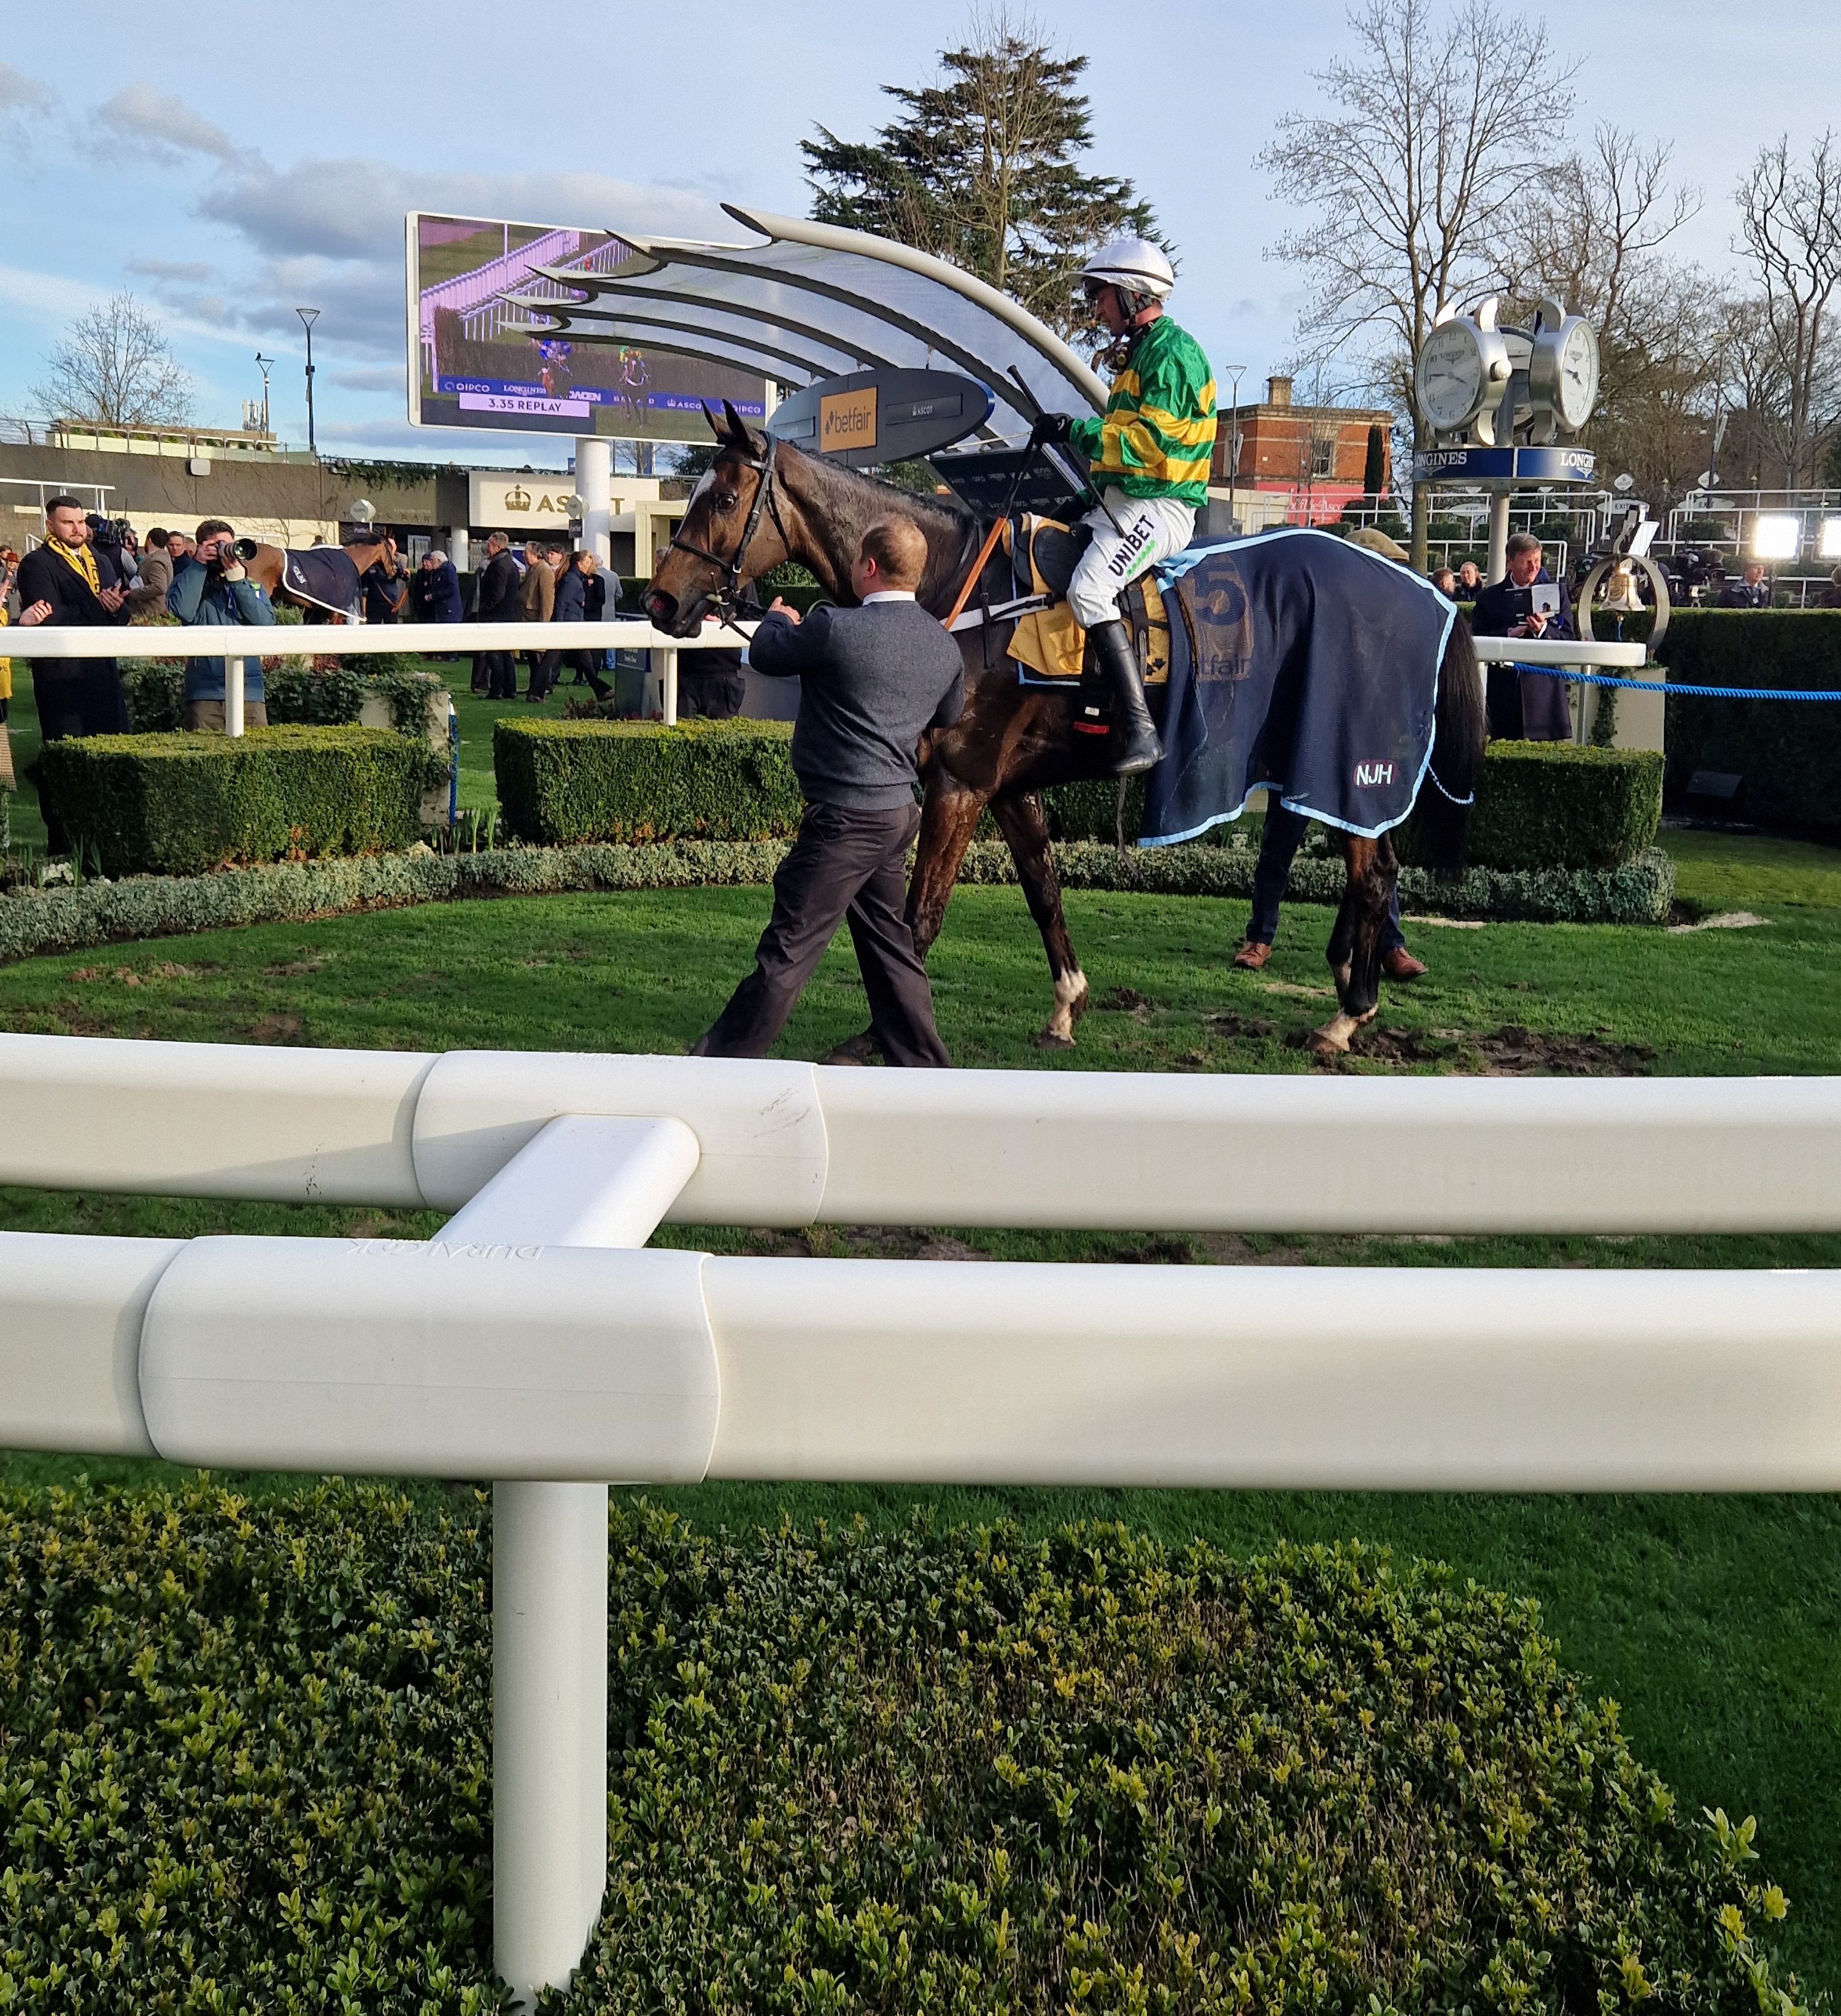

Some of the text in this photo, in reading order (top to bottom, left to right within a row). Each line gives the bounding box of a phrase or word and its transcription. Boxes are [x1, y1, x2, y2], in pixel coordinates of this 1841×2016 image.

[488, 398, 562, 412] 3.35 REPLAY
[676, 401, 702, 410] ASCO
[917, 404, 933, 415] ASCOT
[835, 406, 871, 434] betfair
[536, 495, 625, 516] AST
[1108, 514, 1155, 577] UNIBET
[1357, 763, 1392, 786] NJH
